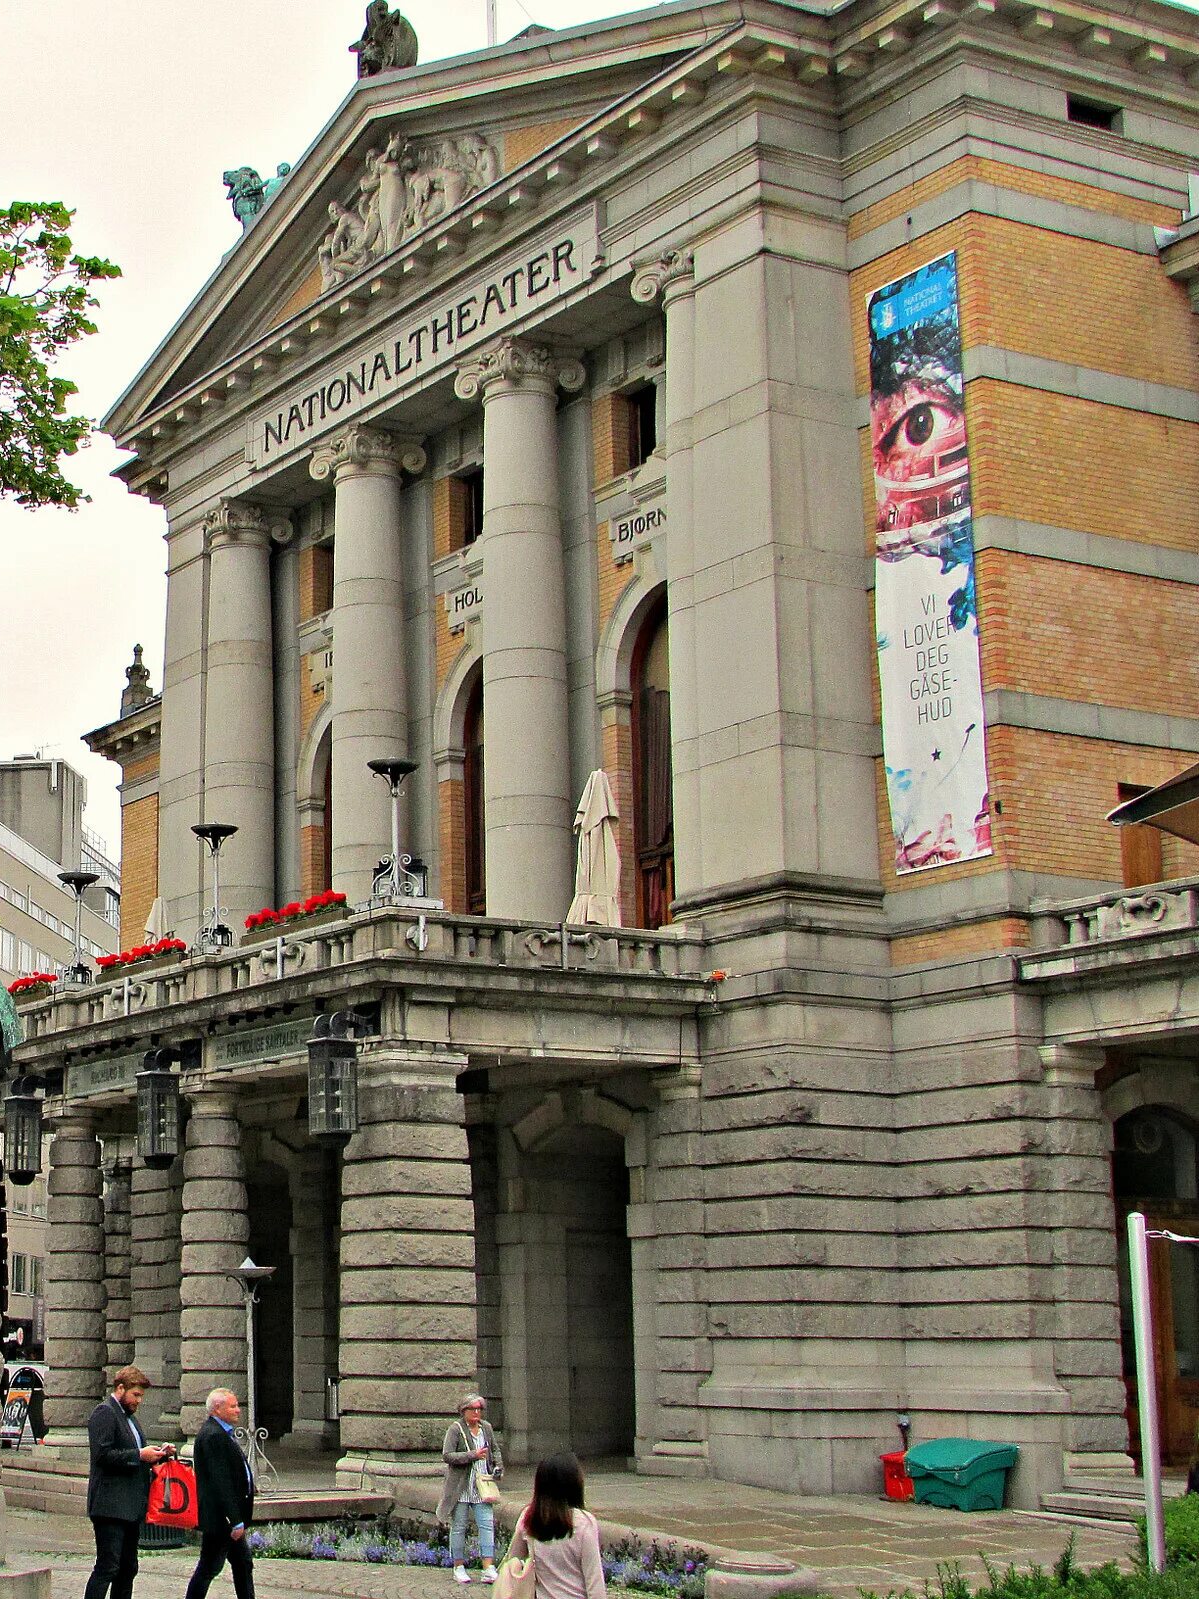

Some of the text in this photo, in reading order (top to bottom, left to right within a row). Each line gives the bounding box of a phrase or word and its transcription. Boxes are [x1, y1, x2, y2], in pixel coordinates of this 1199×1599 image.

[263, 238, 577, 452] NATIONALTHEATER
[920, 593, 936, 616] VI
[916, 643, 949, 672] DEG
[910, 669, 958, 700] GÅSE-
[917, 696, 953, 725] HUD
[158, 1477, 190, 1514] D
